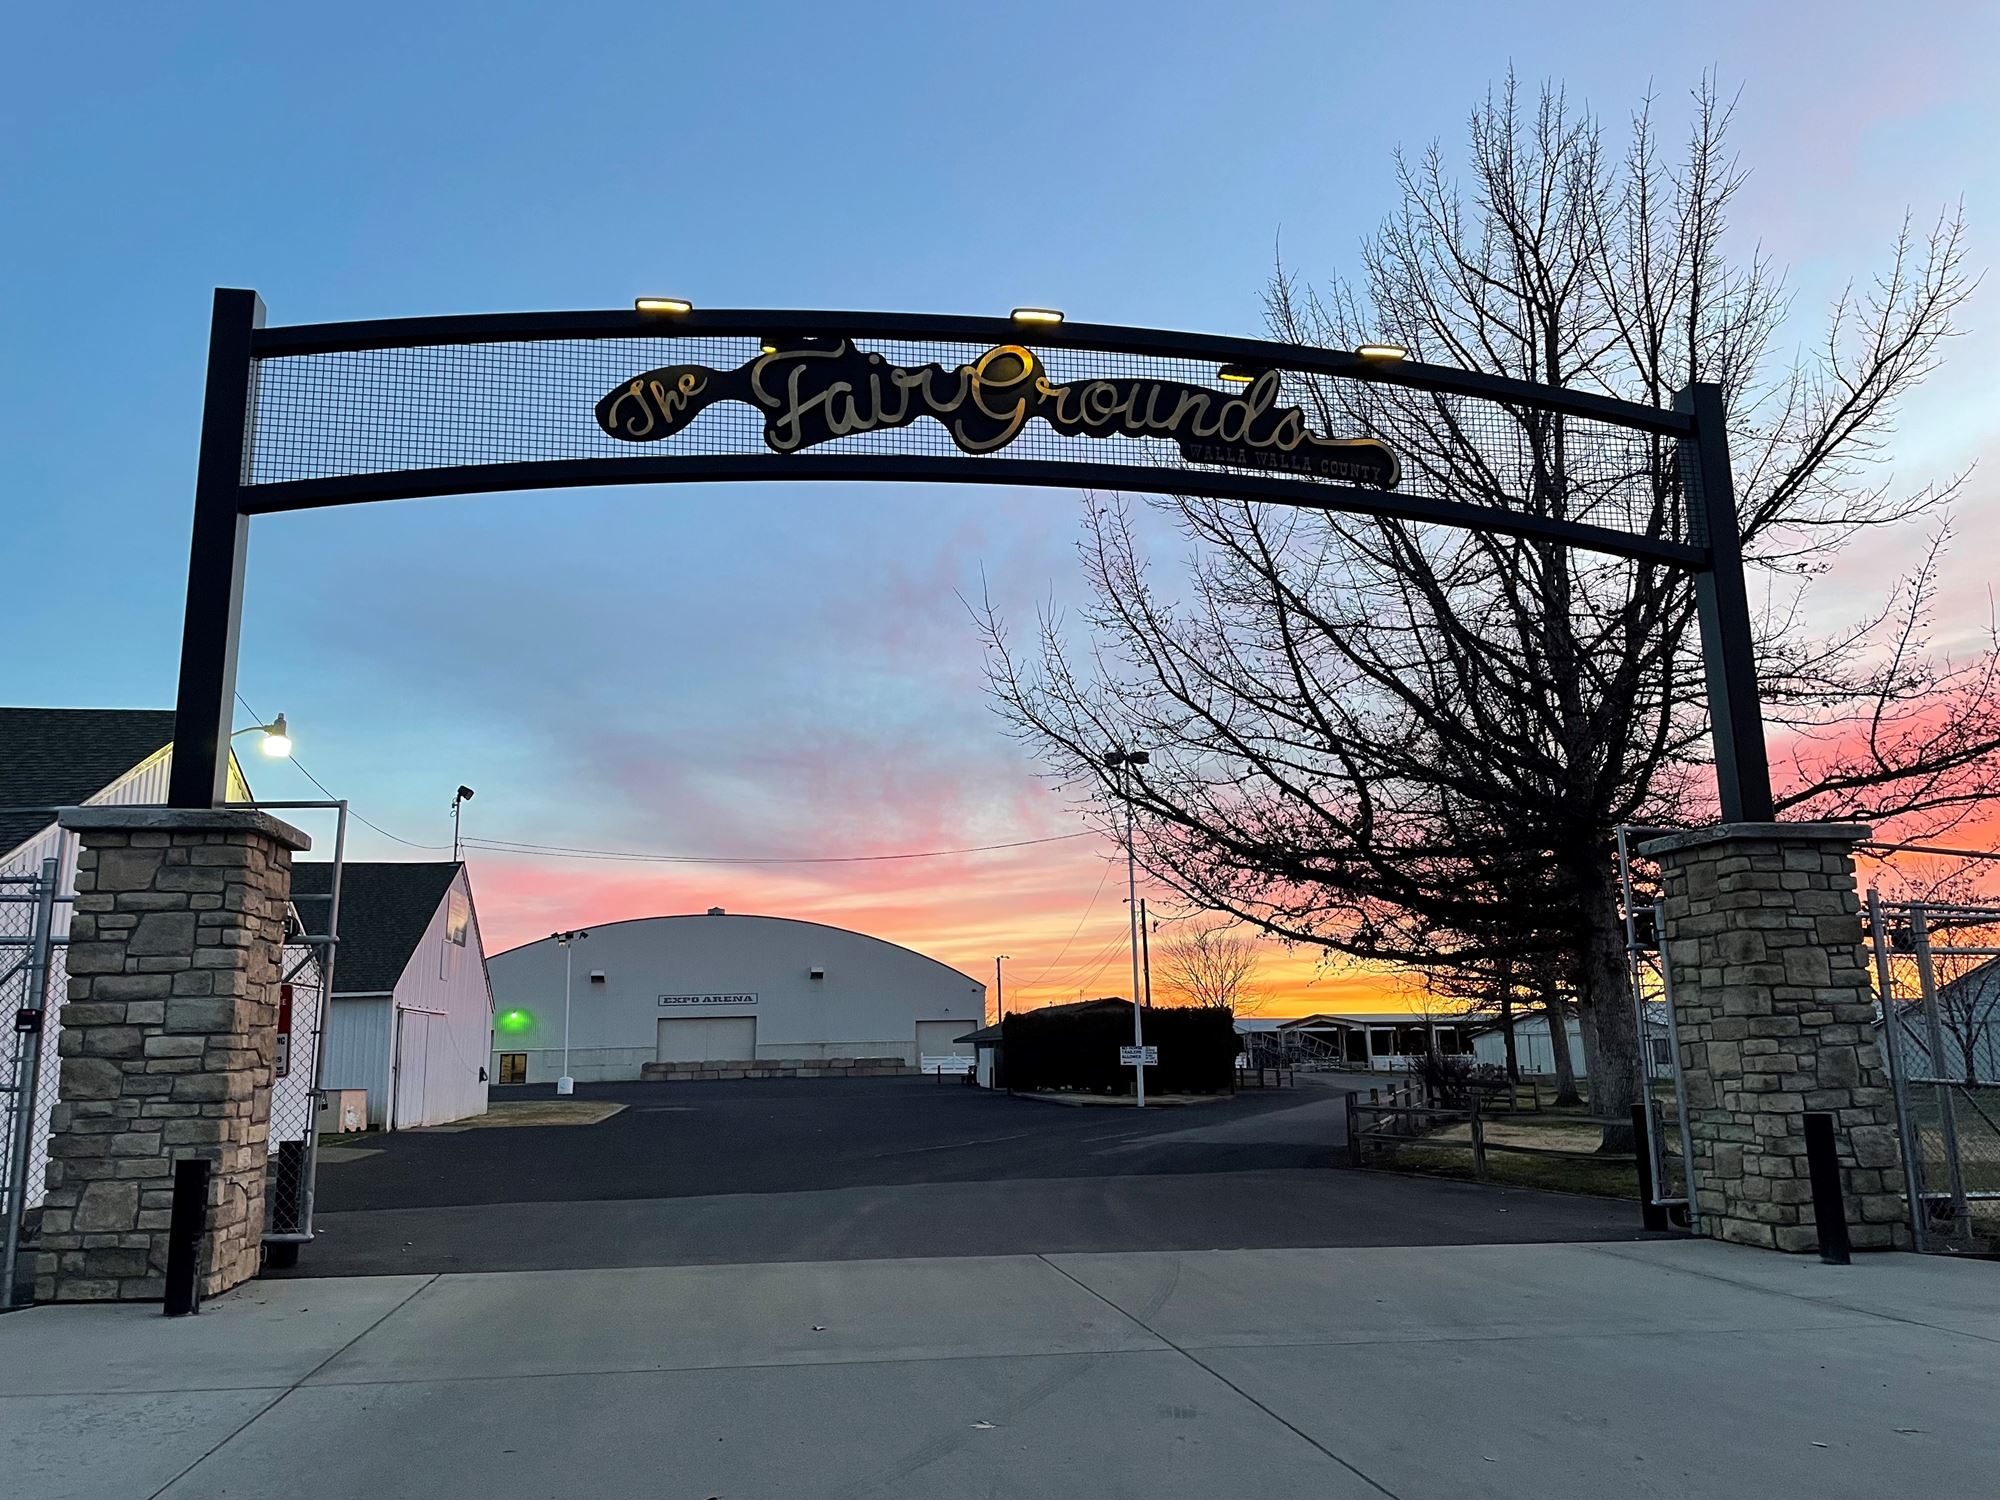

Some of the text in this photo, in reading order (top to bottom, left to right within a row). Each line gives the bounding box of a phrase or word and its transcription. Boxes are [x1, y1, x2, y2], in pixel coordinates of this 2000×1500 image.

[609, 373, 708, 436] The
[1190, 444, 1381, 480] WALLA WALLA COUNTY
[702, 995, 753, 1003] ARENA
